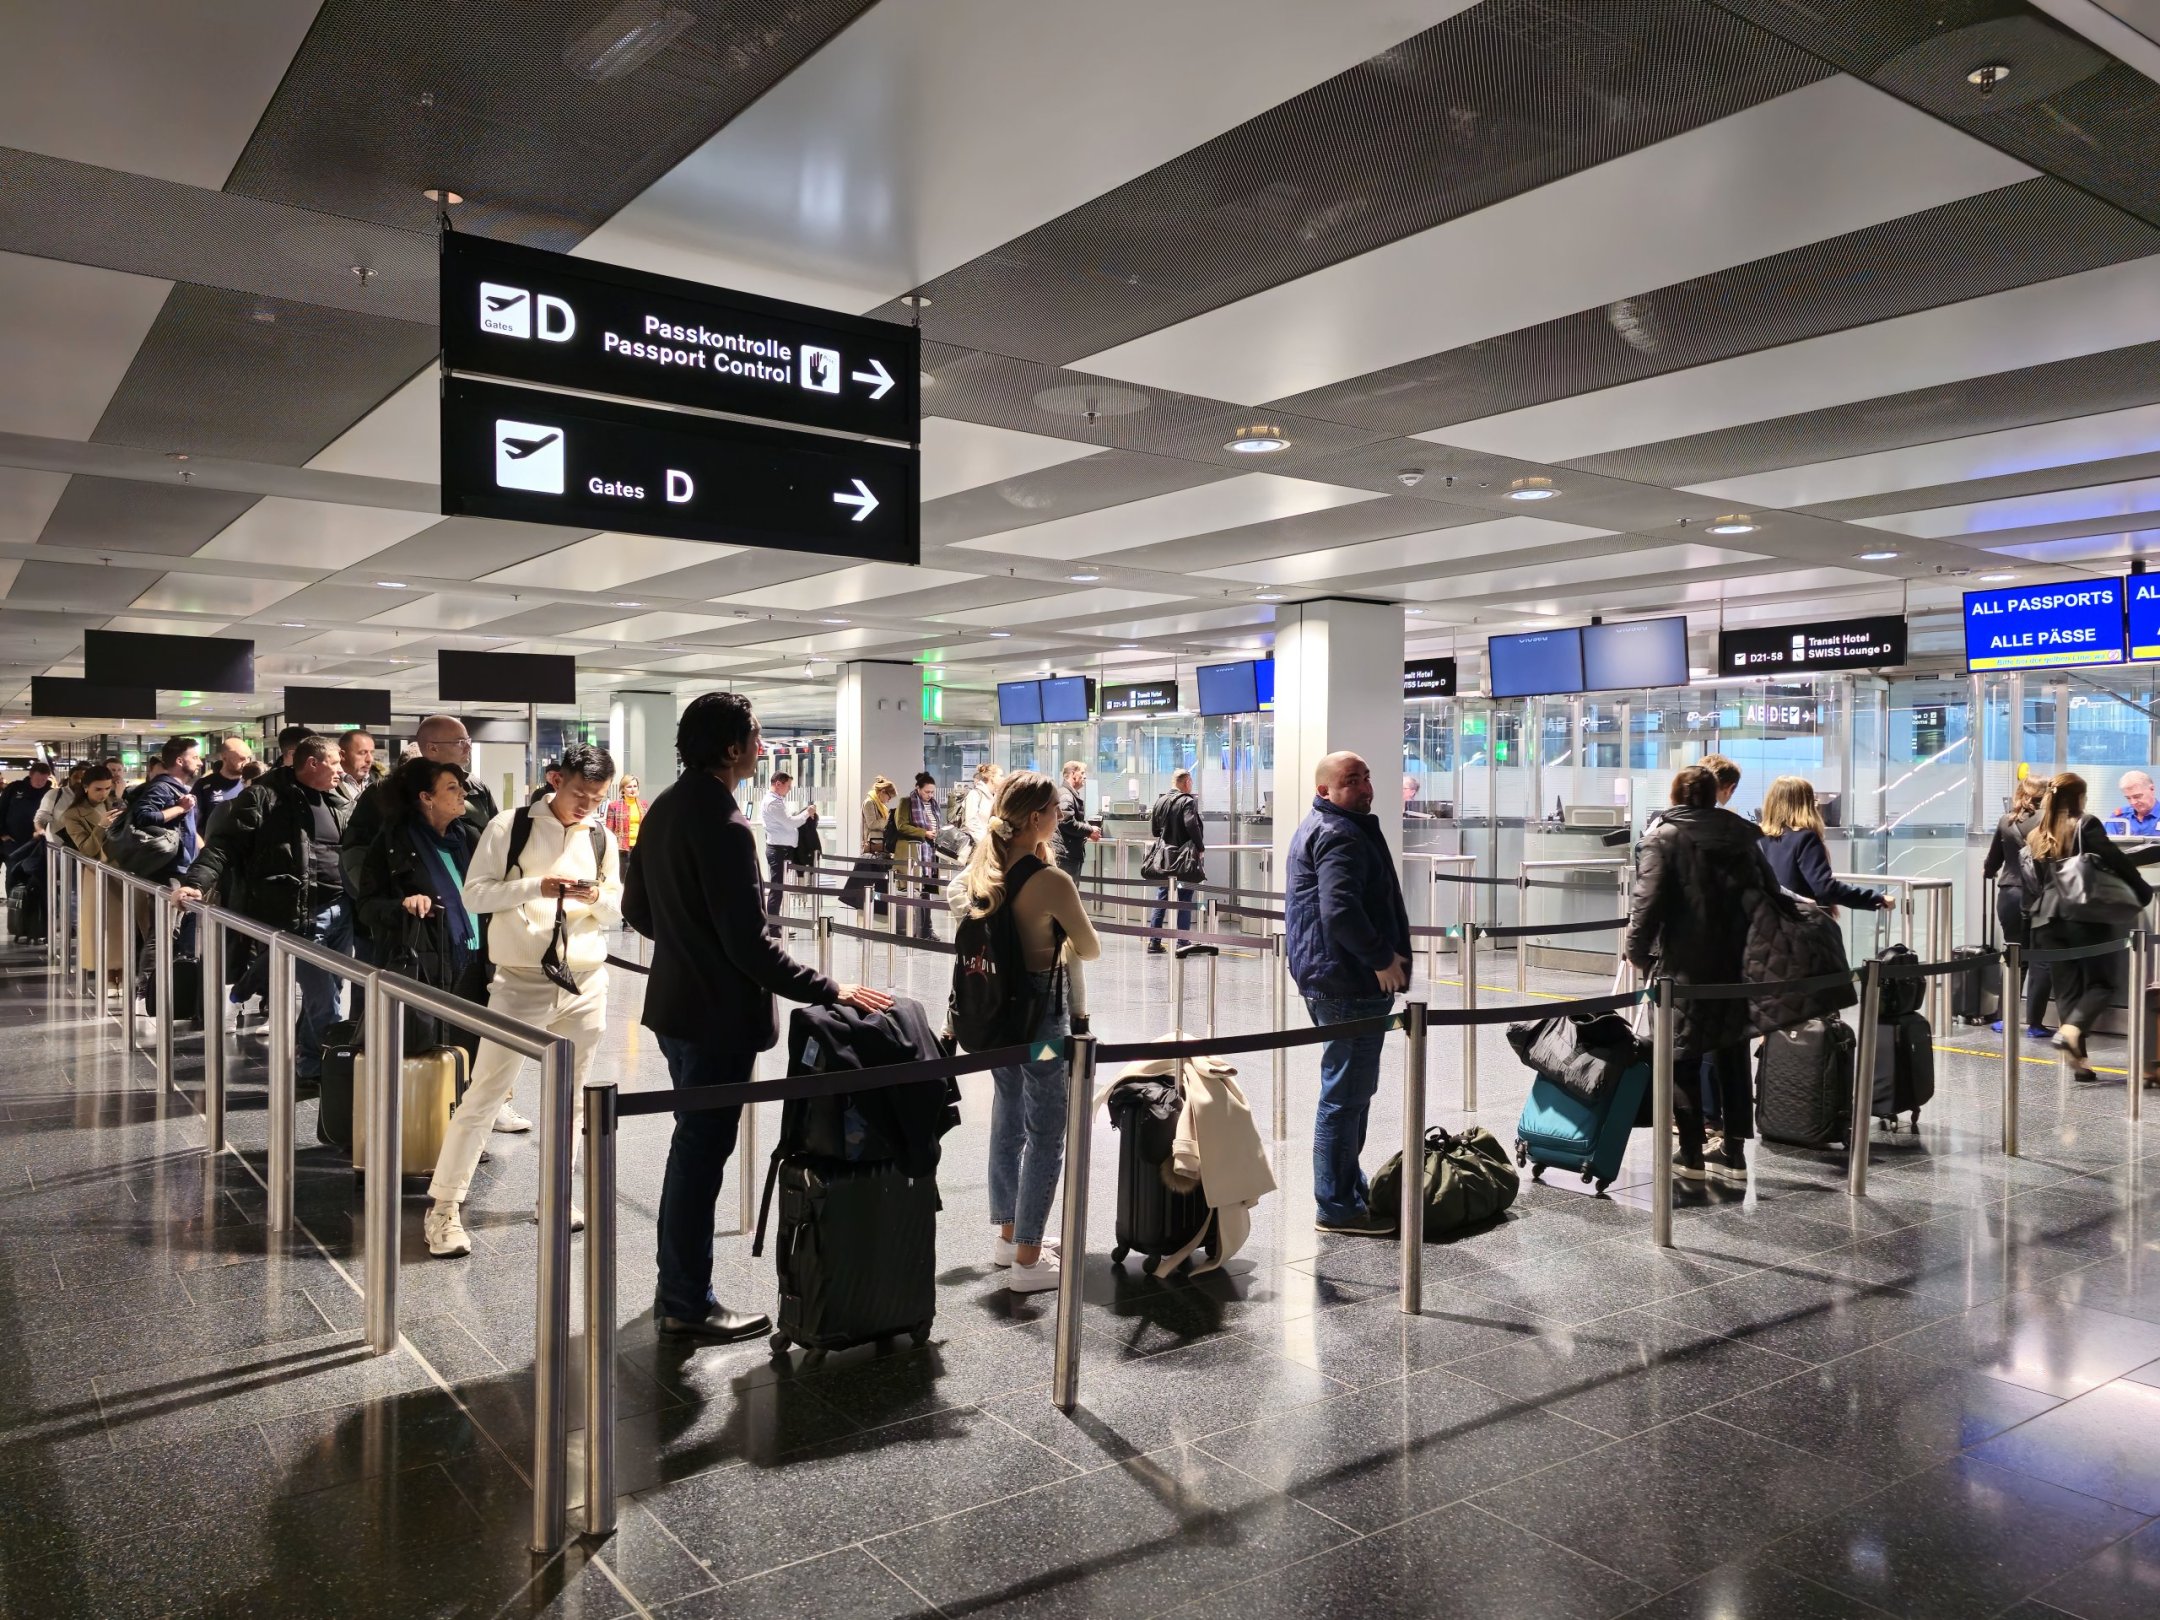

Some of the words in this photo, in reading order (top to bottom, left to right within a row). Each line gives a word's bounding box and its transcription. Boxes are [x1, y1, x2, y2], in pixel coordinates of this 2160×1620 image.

[484, 319, 513, 332] Gates
[537, 293, 576, 342] D
[645, 315, 792, 361] Passkontrolle
[604, 332, 706, 369] Passport
[713, 352, 791, 384] Control
[588, 477, 645, 499] Gates
[666, 469, 694, 503] D
[1971, 601, 2004, 616] ALL
[2007, 590, 2114, 612] PASSPORTS
[1808, 636, 1841, 647] Transit
[1842, 633, 1870, 644] Hotel
[1990, 633, 2034, 649] ALLE
[2038, 628, 2097, 645] PÄSSE
[1750, 652, 1784, 663] D21-58
[1808, 647, 1841, 659] SWISS
[1843, 646, 1880, 656] Lounge
[1882, 644, 1892, 653] D
[1416, 670, 1433, 678] Hotel
[1417, 680, 1439, 688] Lounge
[1746, 704, 1756, 721] A
[1769, 706, 1779, 722] D
[1781, 707, 1789, 723] E
